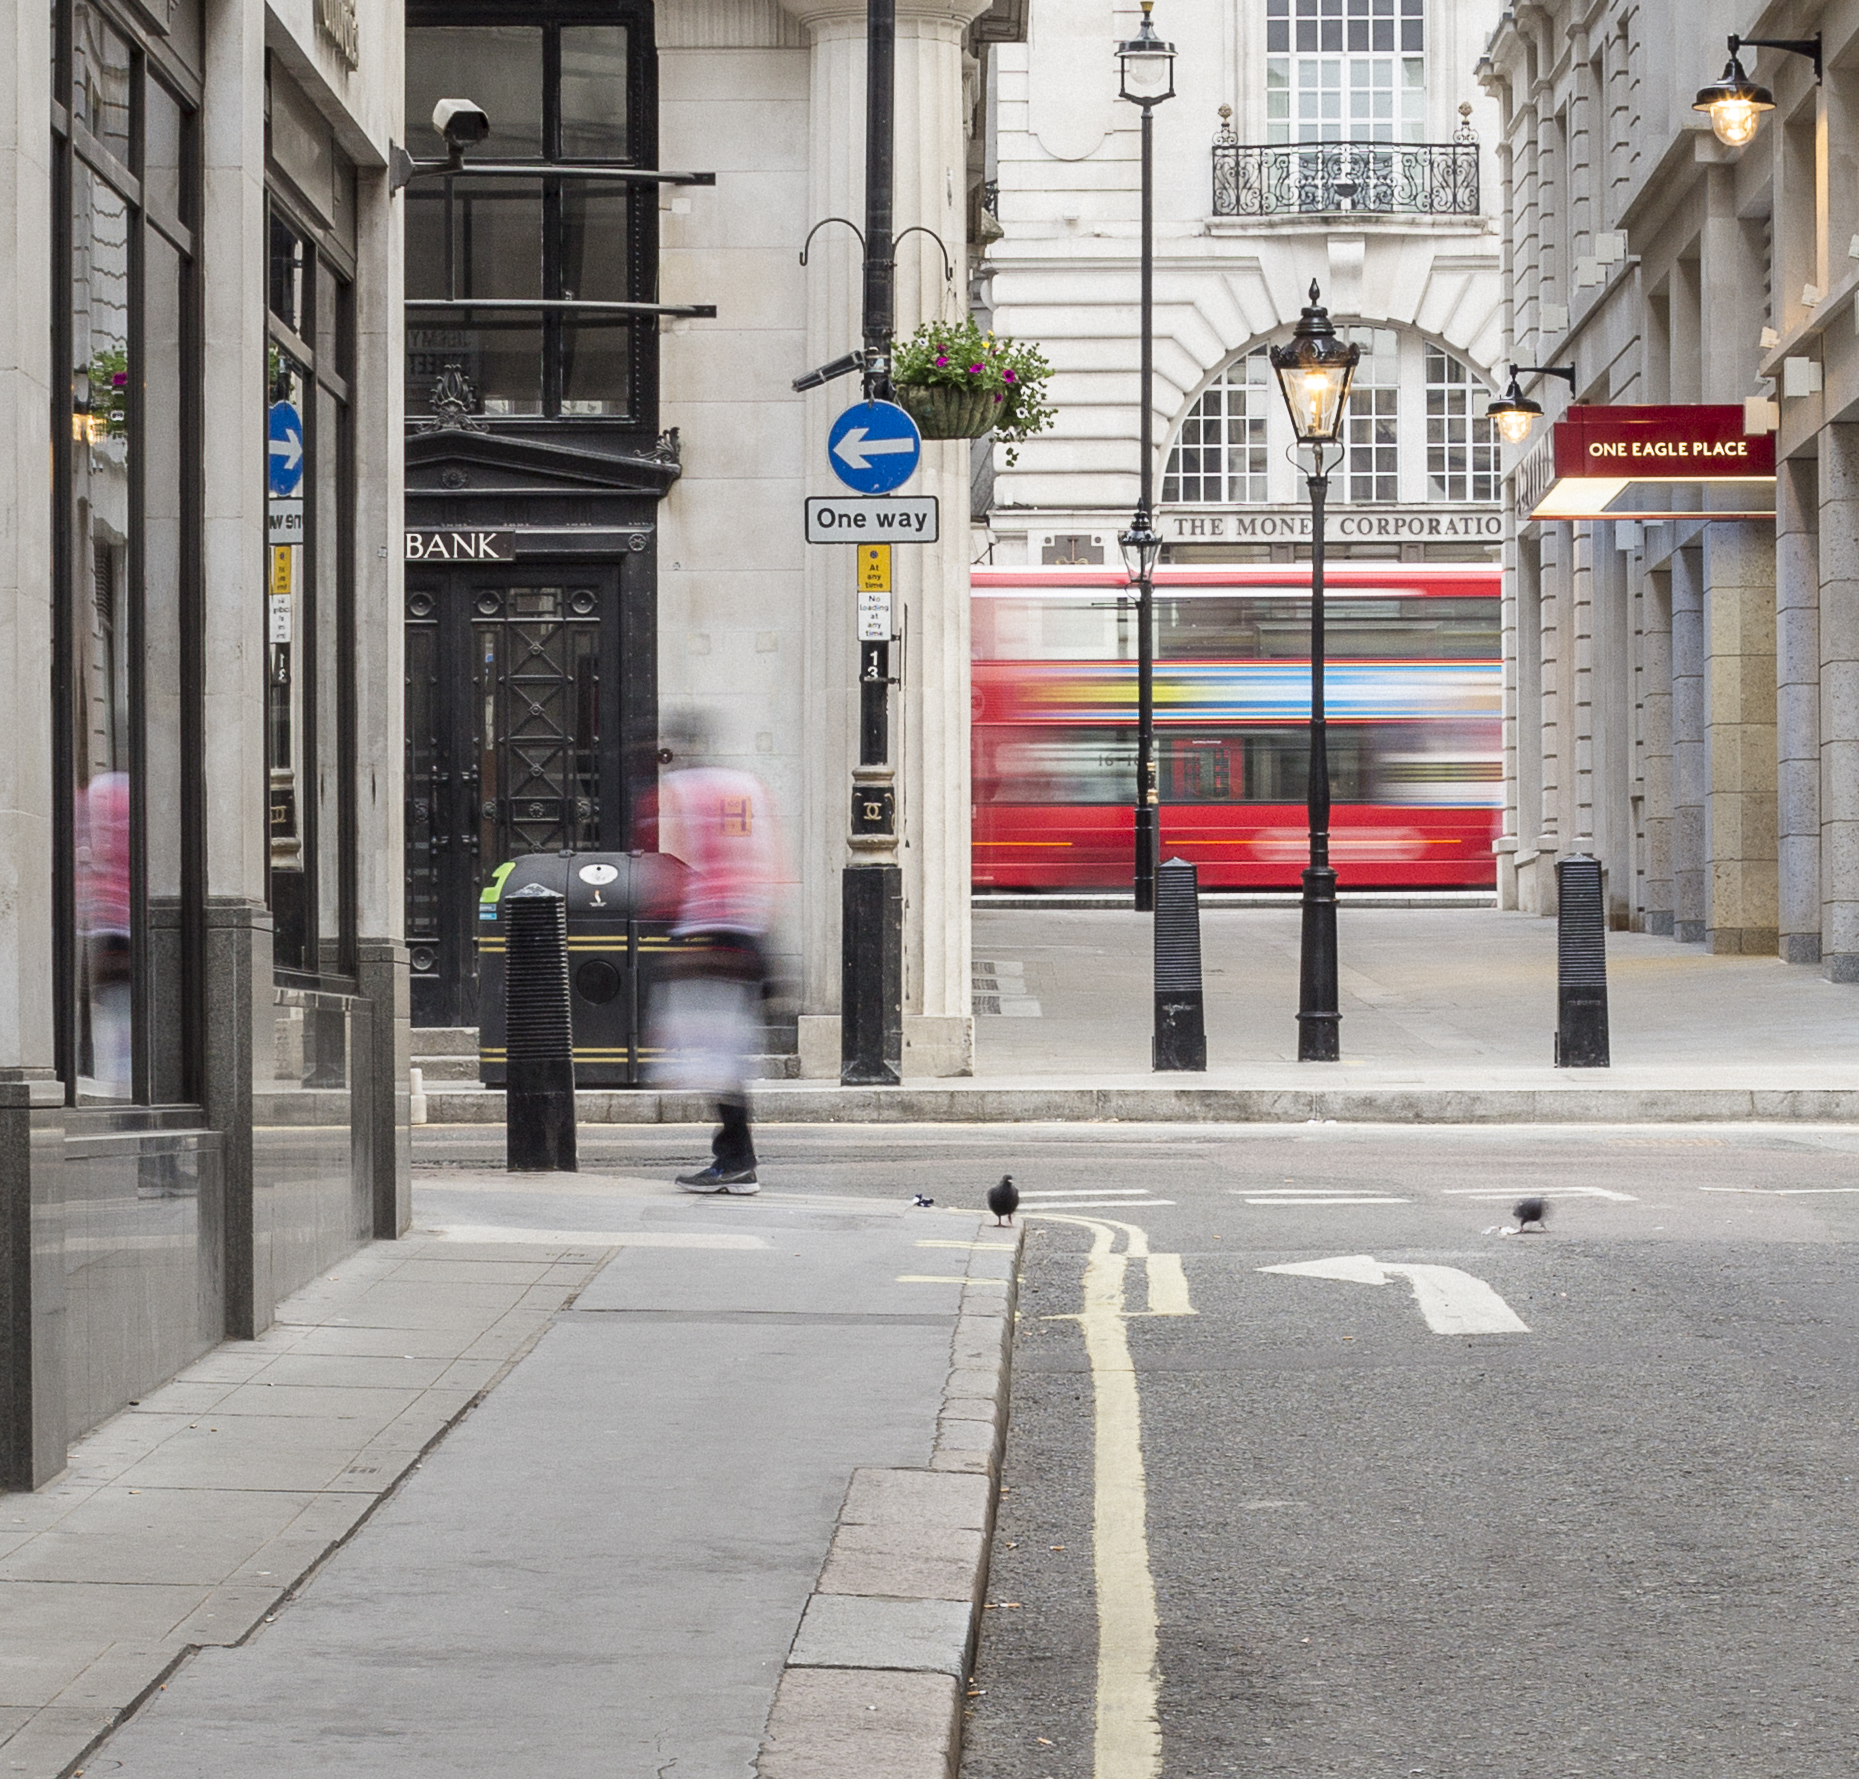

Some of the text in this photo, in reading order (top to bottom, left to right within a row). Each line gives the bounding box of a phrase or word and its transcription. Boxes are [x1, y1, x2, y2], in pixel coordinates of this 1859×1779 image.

[1588, 441, 1748, 457] ONE EAGLE PLACE
[817, 507, 928, 532] One way
[1173, 518, 1224, 536] THE
[1236, 517, 1329, 536] MONE
[405, 532, 500, 559] BANK
[859, 604, 889, 612] loading
